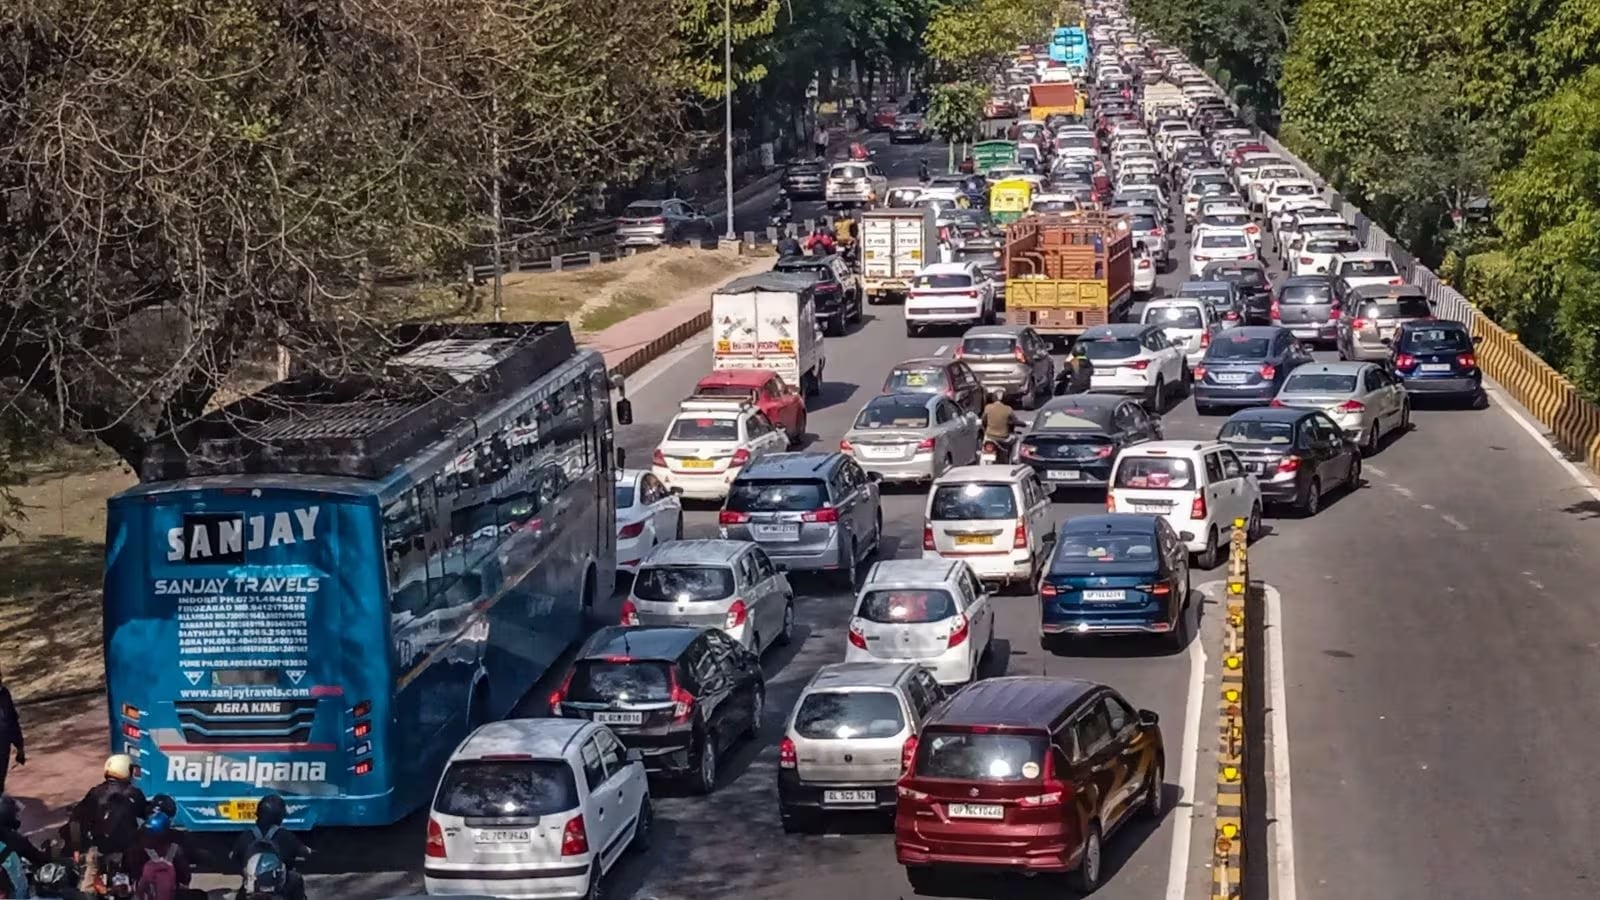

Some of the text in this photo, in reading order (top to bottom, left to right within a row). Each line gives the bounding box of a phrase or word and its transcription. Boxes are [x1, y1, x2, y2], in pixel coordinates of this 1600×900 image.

[167, 505, 320, 561] SANJAY
[154, 577, 320, 595] SANJAY TRAVELS
[180, 687, 310, 700] www.sanjaytravels.com
[213, 702, 282, 713] AGRA KING
[166, 748, 326, 788] Rajkalpana
